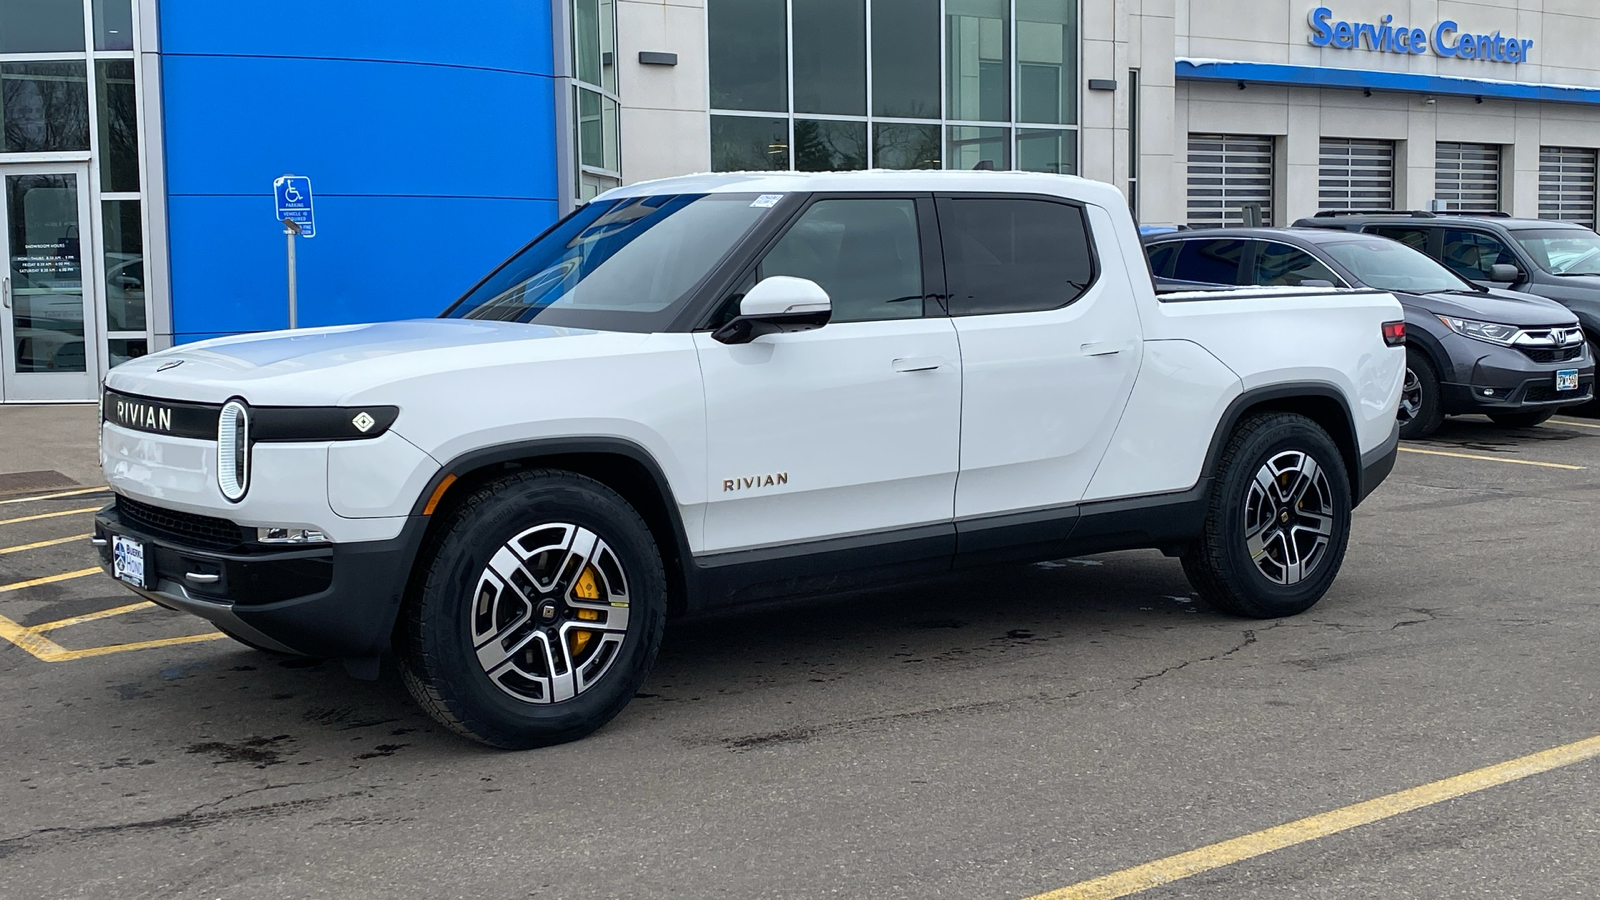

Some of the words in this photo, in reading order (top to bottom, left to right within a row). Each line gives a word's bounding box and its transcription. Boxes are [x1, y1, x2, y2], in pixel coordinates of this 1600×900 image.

[1307, 7, 1426, 54] Service
[1430, 20, 1533, 63] Center
[117, 401, 171, 431] RIVIAN
[723, 472, 788, 492] RIVIAN
